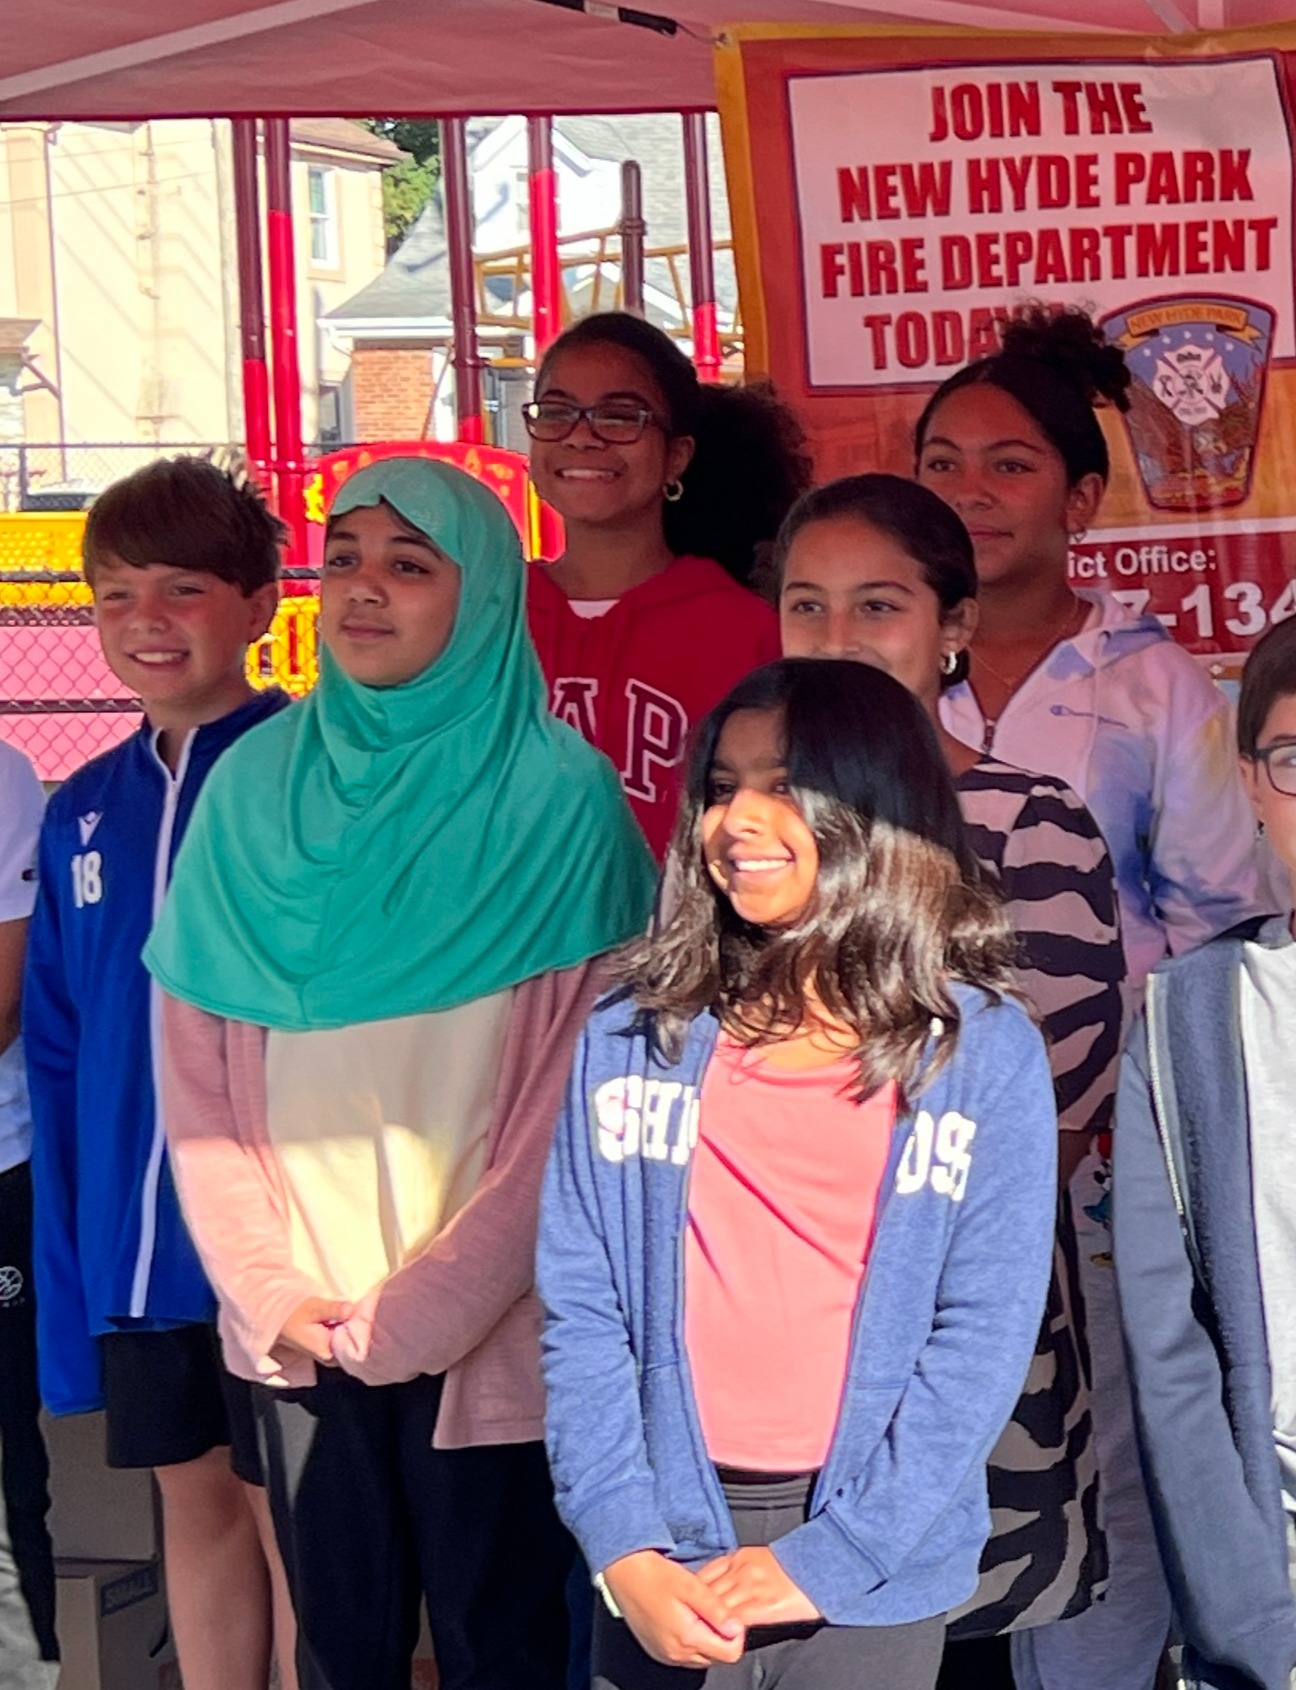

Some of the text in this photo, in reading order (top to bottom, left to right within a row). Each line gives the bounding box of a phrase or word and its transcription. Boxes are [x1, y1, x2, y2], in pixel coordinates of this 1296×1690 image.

[928, 81, 1154, 142] JOIN THE
[837, 148, 1255, 224] NEW HYDE PARK
[820, 217, 1279, 299] FIRE DEPARTMENT
[864, 302, 1066, 370] TODA
[1114, 545, 1216, 576] Office:
[71, 850, 103, 909] 18
